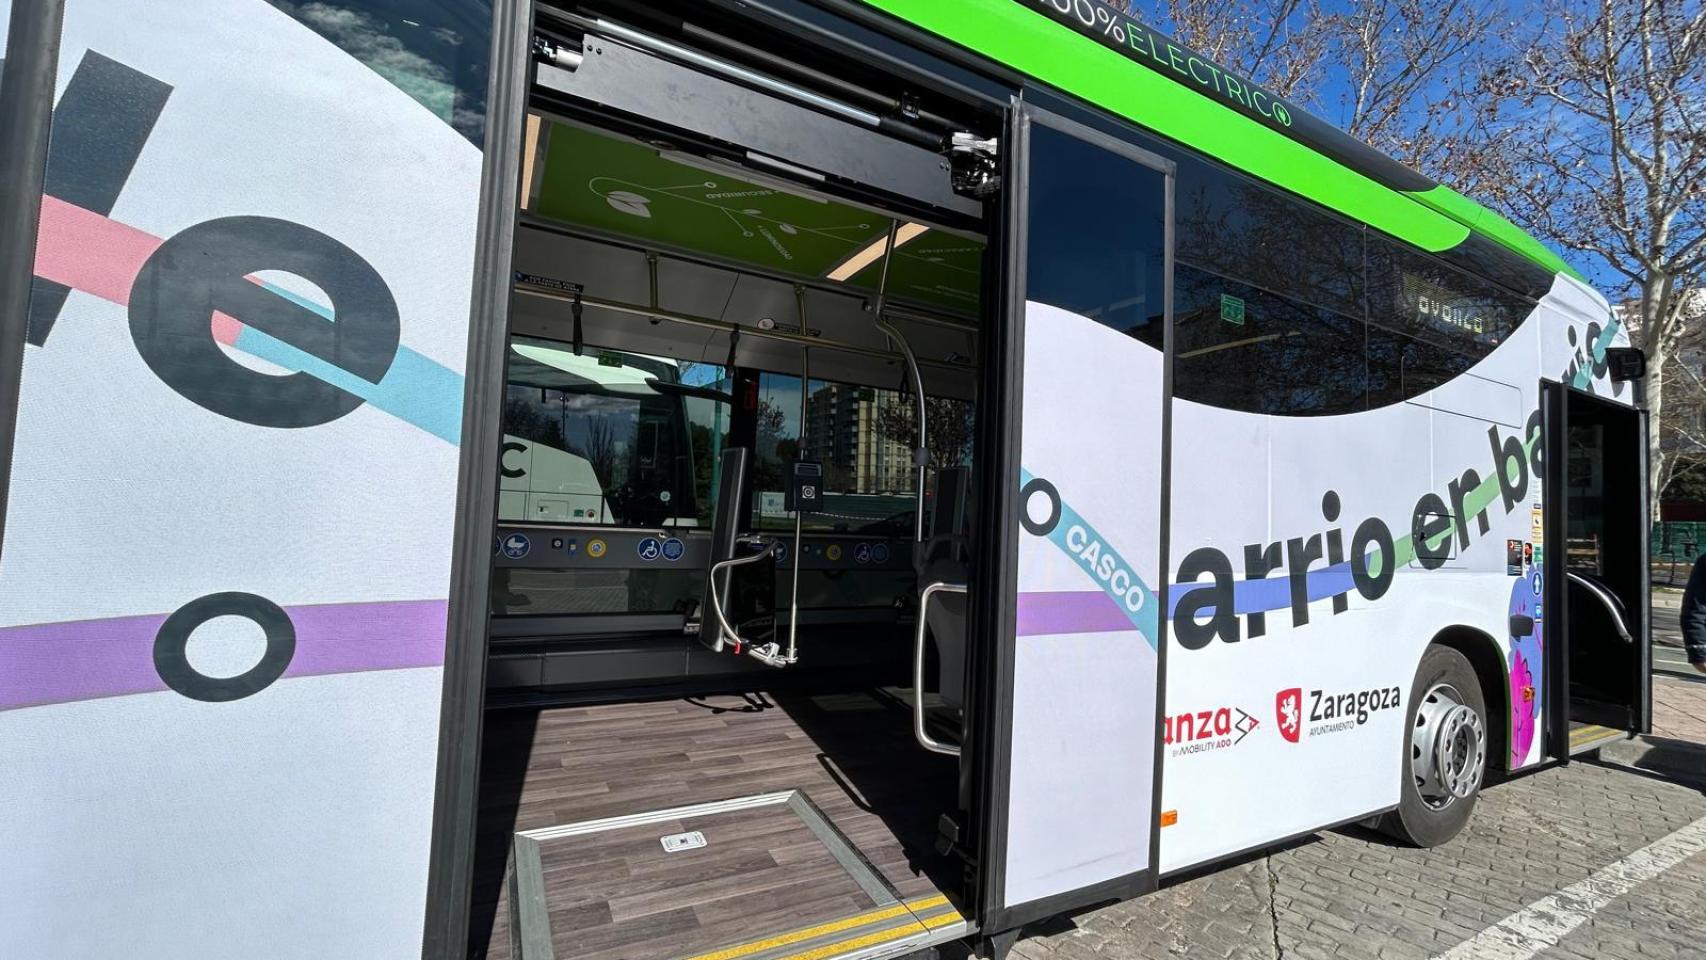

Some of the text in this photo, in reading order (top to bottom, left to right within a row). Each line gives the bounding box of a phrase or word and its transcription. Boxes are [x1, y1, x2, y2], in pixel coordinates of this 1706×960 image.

[1065, 524, 1144, 612] CASCO
[1173, 489, 1396, 650] arrio
[1411, 468, 1491, 570] en
[1309, 686, 1401, 725] Zaragoza
[1179, 741, 1215, 756] MOBILITY
[1215, 738, 1232, 749] ADO
[1309, 720, 1355, 736] AYUNTAMIENTO
